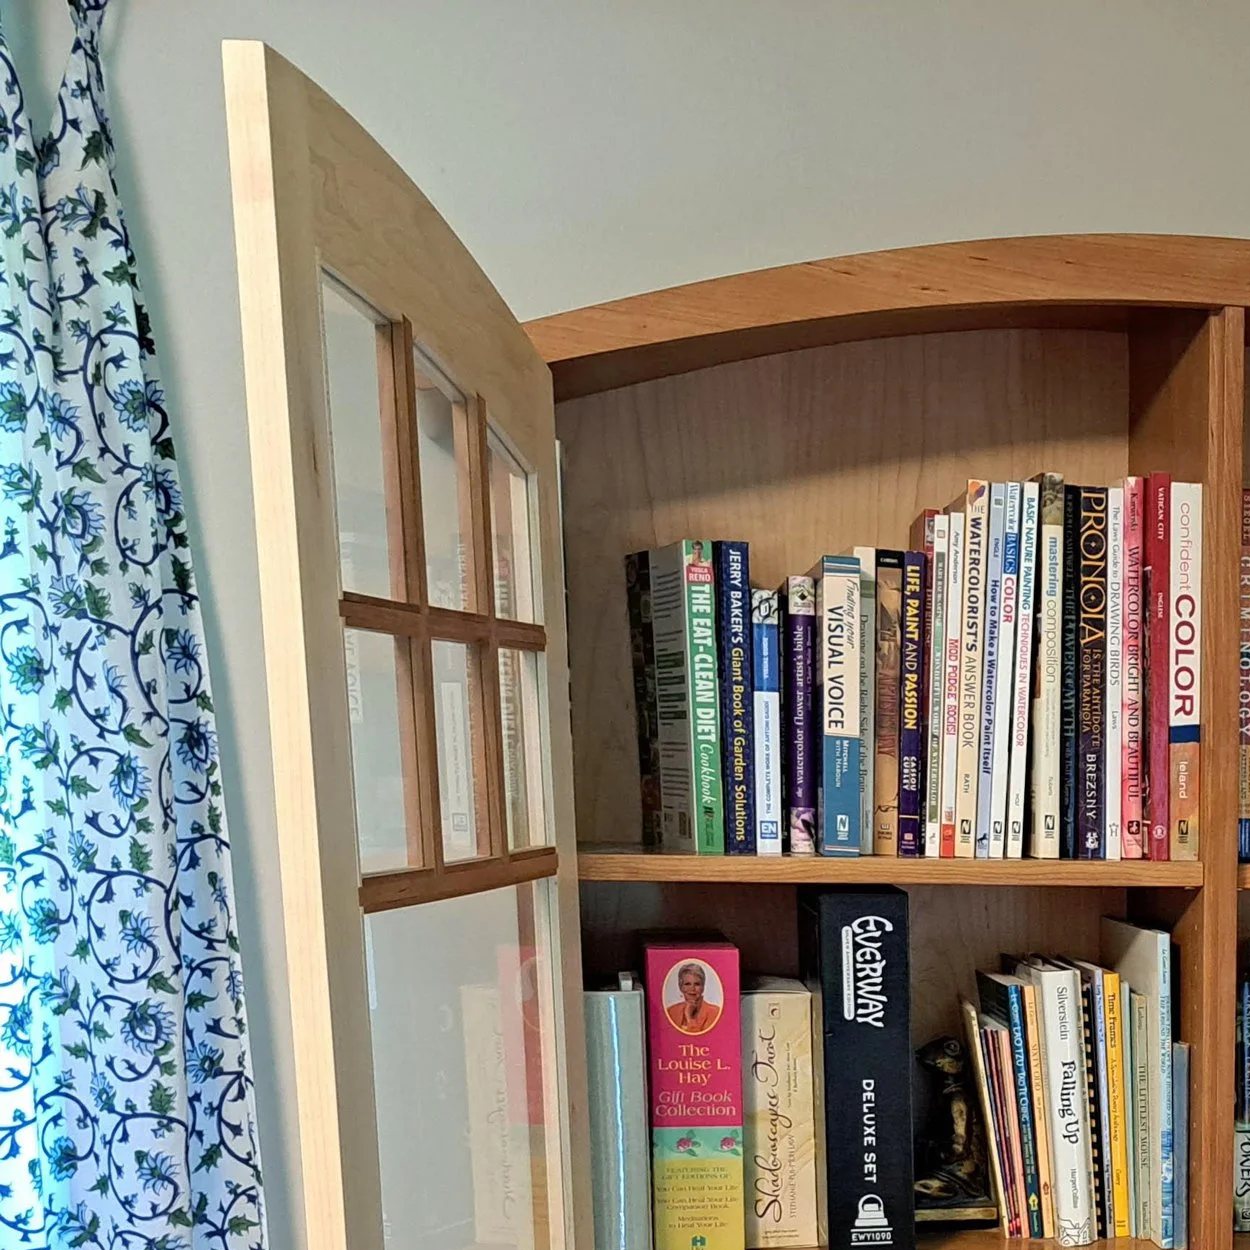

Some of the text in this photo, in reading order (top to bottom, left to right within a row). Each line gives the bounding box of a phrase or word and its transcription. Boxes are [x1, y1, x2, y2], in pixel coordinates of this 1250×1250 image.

[1045, 537, 1060, 597] mastering
[1080, 491, 1108, 647] PRONOIA
[1126, 546, 1139, 641] WATERCOLOR
[905, 565, 921, 729] LIFE, PAINT AND PASSION
[962, 517, 983, 748] WATERCOLORIST'S ANSWER BOOK
[1015, 497, 1035, 747] BASIC NATURE PAINTING TECHNIQUES IN WATERCOLOR
[1043, 600, 1059, 683] composition
[1174, 503, 1196, 716] confident COLOR
[690, 584, 718, 805] THE EAT-CLEAN DIET Cookbook
[728, 550, 748, 841] JERRY BAKER'S Giant Book of Garden Solutions
[827, 606, 844, 728] VISUAL VOICE
[1127, 644, 1140, 694] BRIGHT
[1127, 698, 1139, 727] AND
[1085, 754, 1097, 819] BREZSNY
[1127, 731, 1140, 803] BEAUTIFUL
[851, 915, 894, 1028] EVERWAY
[678, 1045, 710, 1057] The
[1057, 987, 1069, 1041] Silverstein
[658, 1058, 731, 1071] Louise L.
[658, 1090, 731, 1103] Gift Book
[679, 1071, 712, 1085] Hay
[1058, 1060, 1080, 1145] Falling Up
[656, 1104, 736, 1117] Collection
[862, 1079, 877, 1184] DELUXE SET
